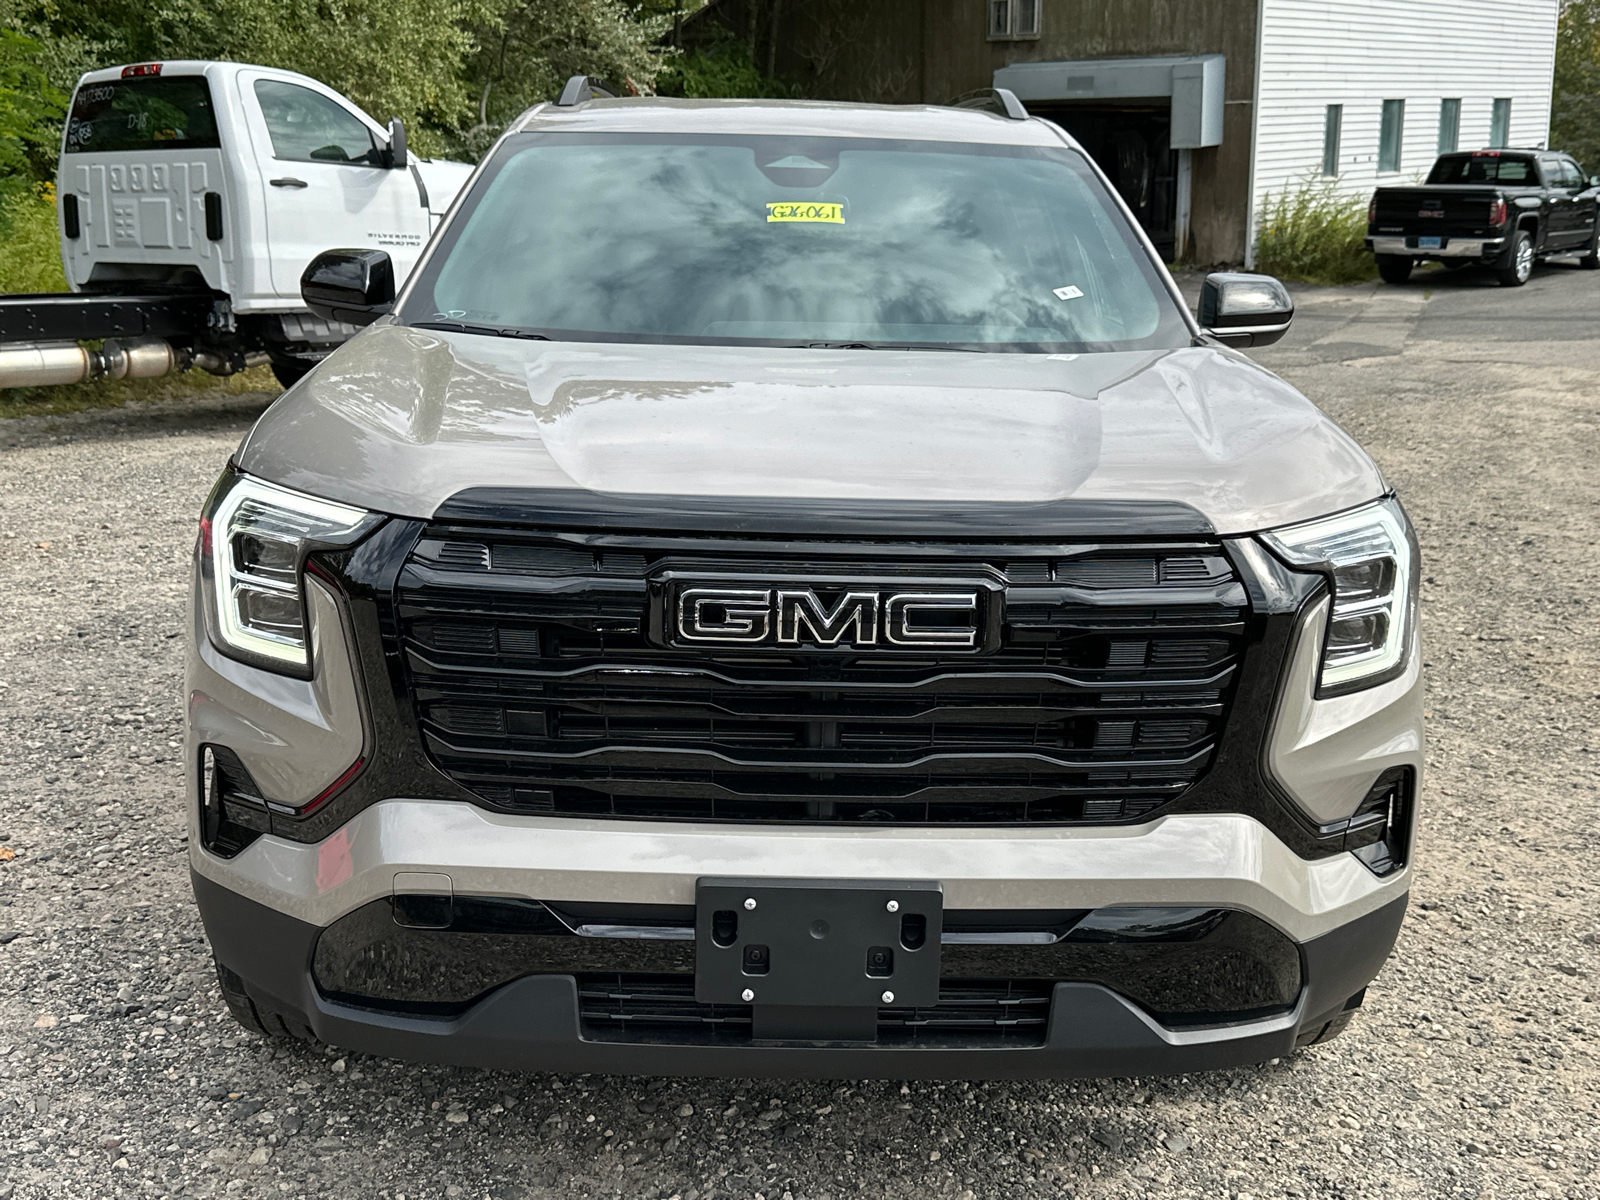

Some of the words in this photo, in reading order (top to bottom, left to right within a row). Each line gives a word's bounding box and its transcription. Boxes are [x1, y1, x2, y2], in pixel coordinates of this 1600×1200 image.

[772, 205, 836, 218] G26061
[1418, 209, 1445, 218] GMC
[678, 588, 978, 647] GMC
